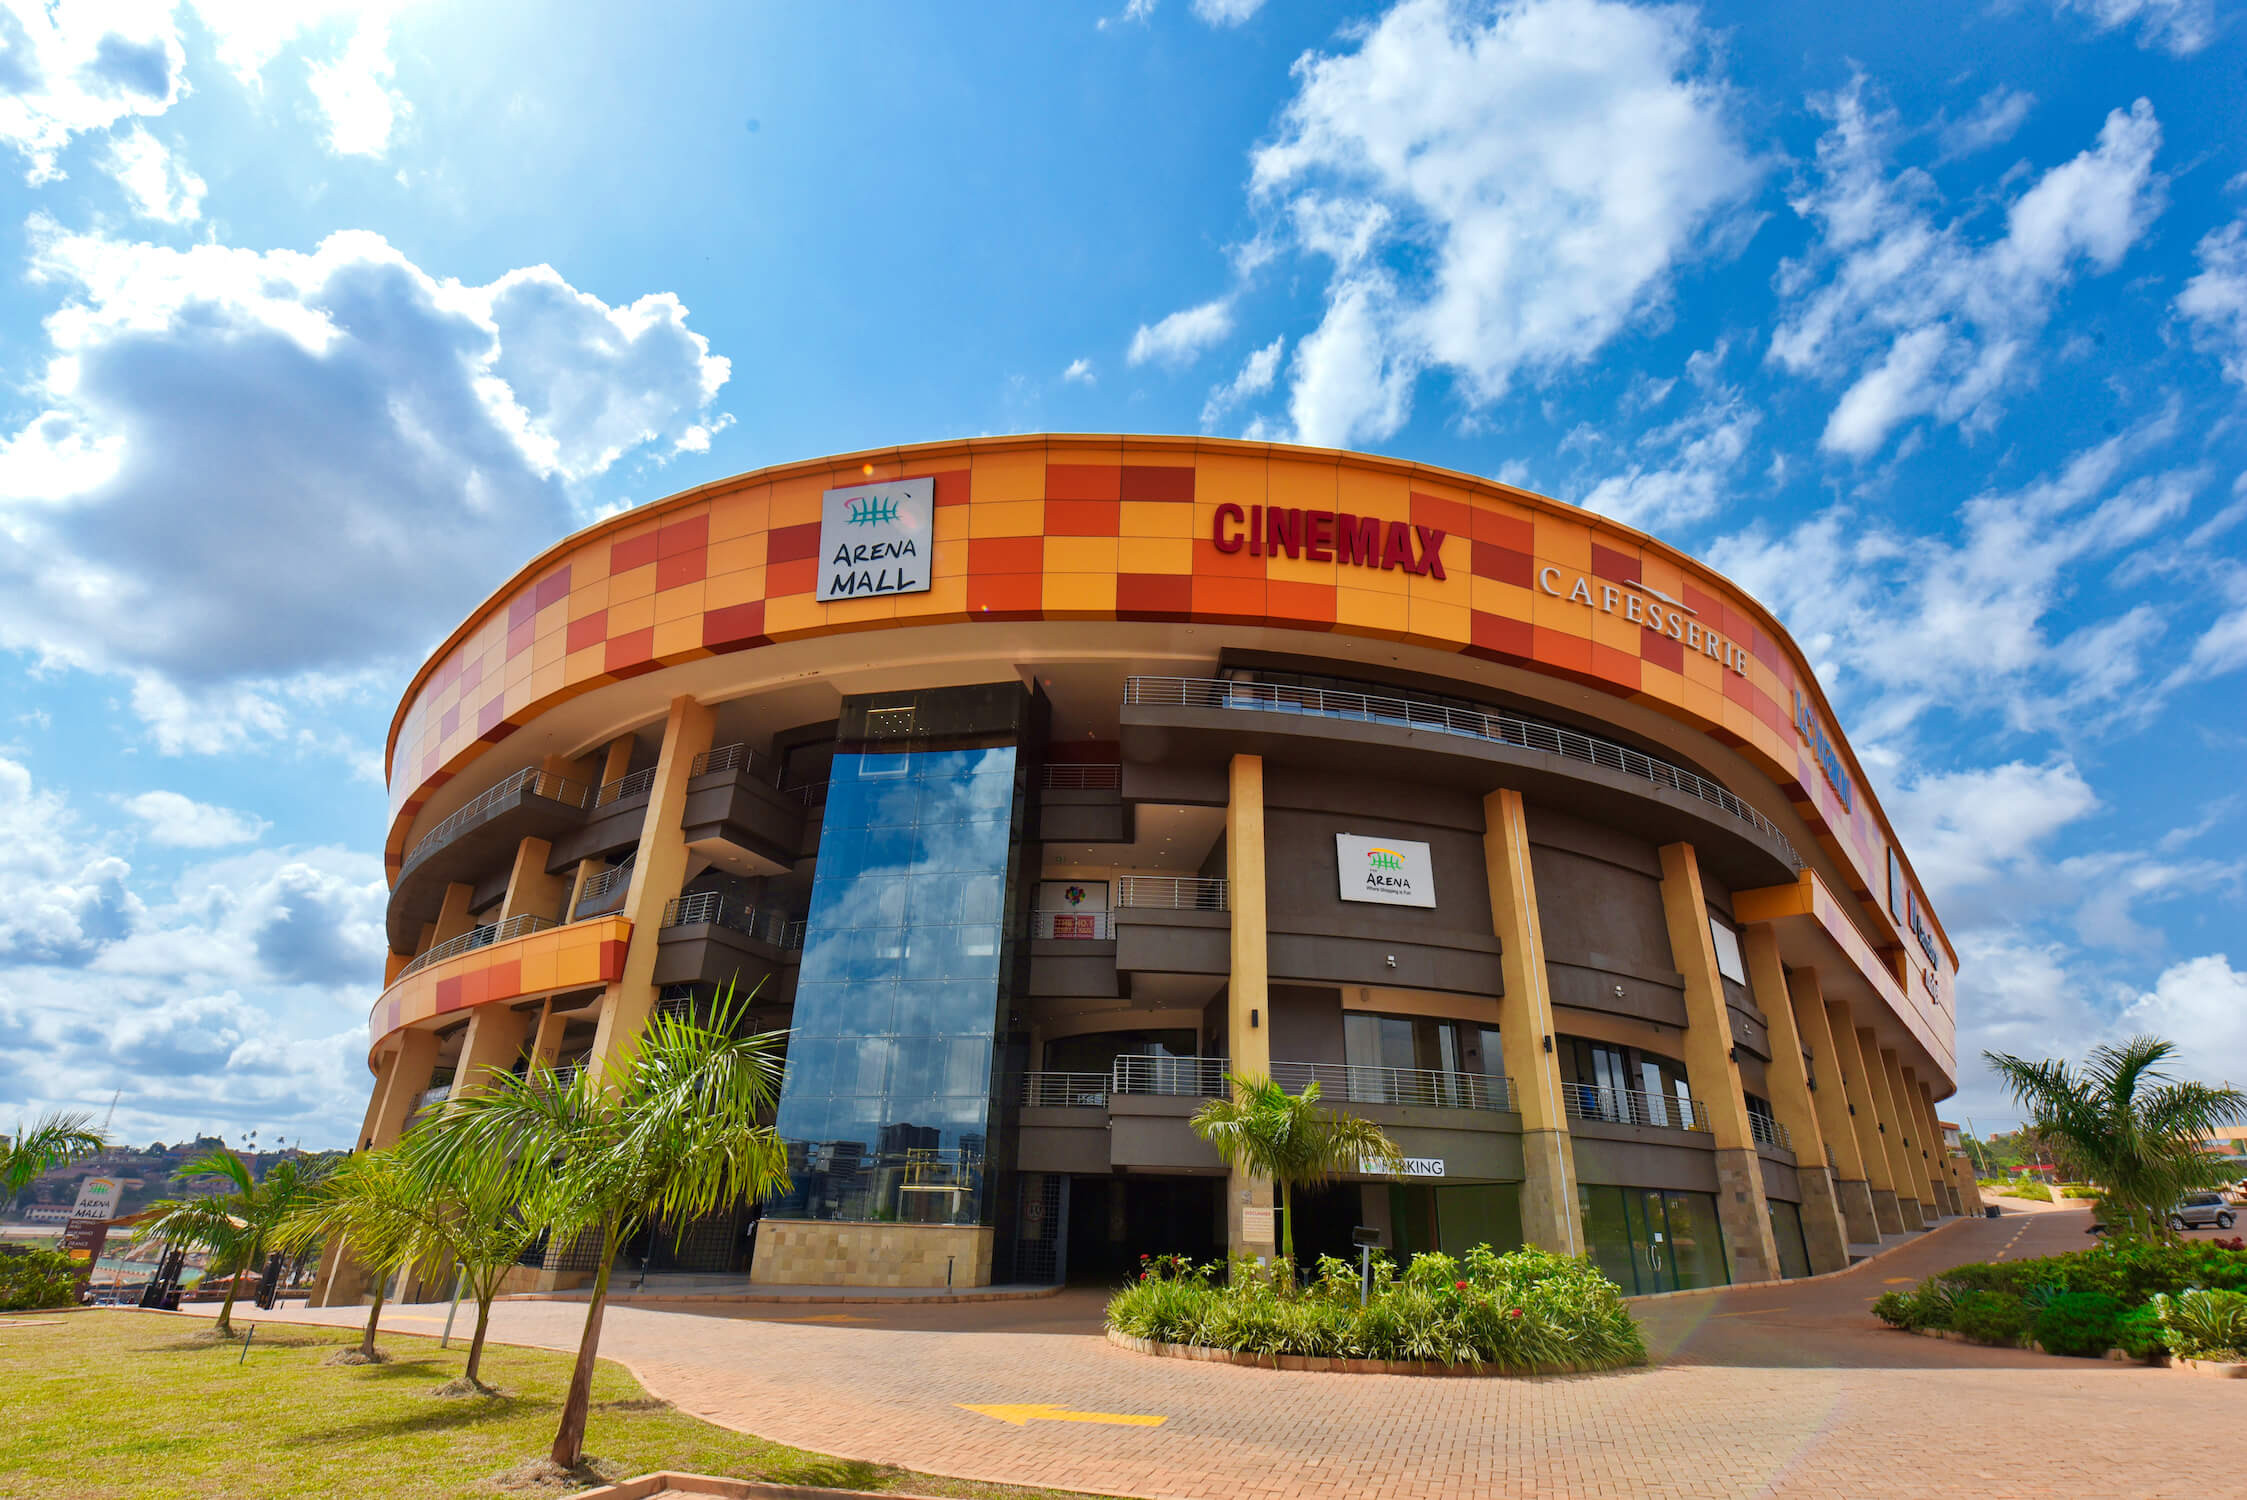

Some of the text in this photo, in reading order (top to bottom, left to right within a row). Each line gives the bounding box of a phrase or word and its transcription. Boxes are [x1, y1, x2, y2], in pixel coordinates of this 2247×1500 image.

[833, 539, 916, 567] ARENA
[1213, 503, 1447, 581] CINEMAX
[830, 567, 916, 595] MALL
[1539, 567, 1748, 677] CAFESSERIE
[1366, 873, 1411, 889] ARENA
[1382, 1159, 1443, 1175] PRKING
[75, 1209, 106, 1218] MALL
[80, 1199, 110, 1208] ARENA
